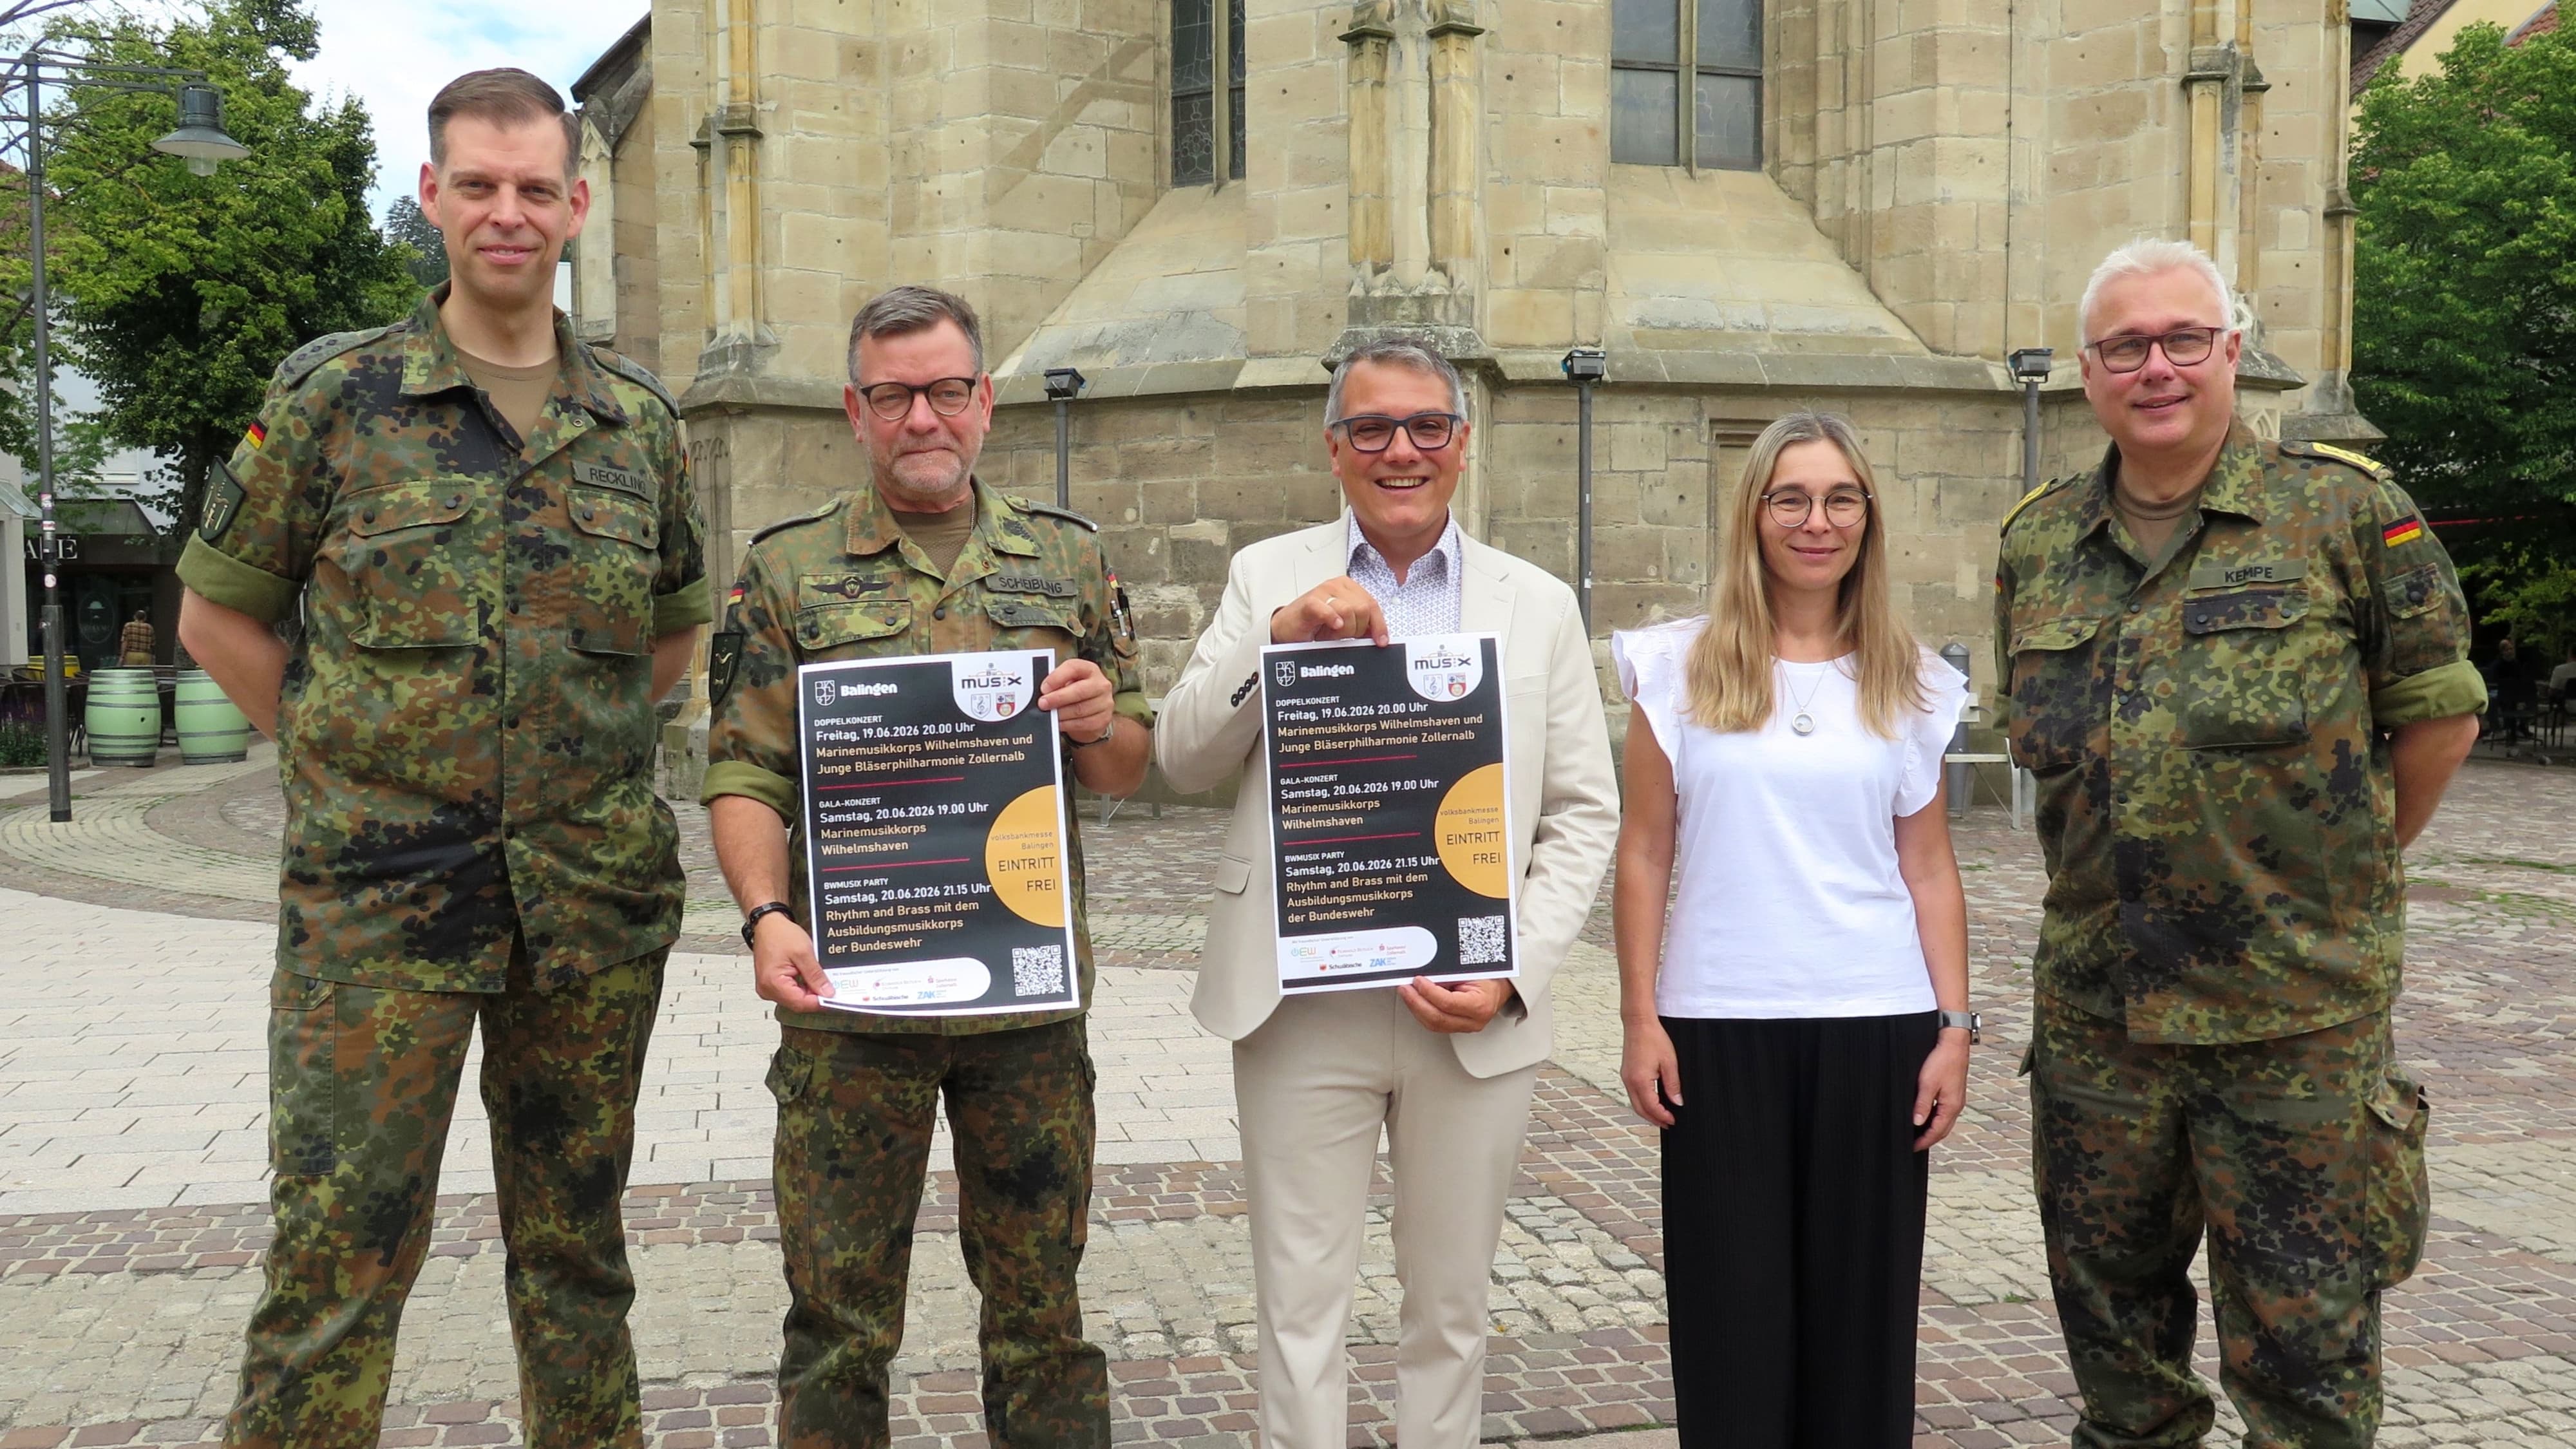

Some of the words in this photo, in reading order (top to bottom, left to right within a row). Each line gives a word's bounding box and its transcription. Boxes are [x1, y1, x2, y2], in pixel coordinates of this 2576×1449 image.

[589, 468, 647, 494] RECKLING
[2225, 567, 2273, 583] KEMPE
[1301, 665, 1354, 677] Balingen
[840, 683, 898, 697] Balingen
[1276, 696, 1340, 706] DOPPELKONZERT
[1278, 710, 1318, 721] Freitag,
[1321, 706, 1374, 717] 19.06.2026
[1378, 703, 1405, 714] 20.00
[1409, 702, 1428, 712] Uhr
[814, 715, 882, 726] DOPPELKONZERT
[1278, 723, 1376, 737] Marinemusikkorps
[1380, 717, 1460, 729] Wilhelmshaven
[1464, 714, 1482, 724] und
[817, 730, 860, 742] Freitag,
[863, 726, 919, 738] 19.06.2026
[923, 724, 952, 734] 20.00
[956, 723, 975, 732] Uhr
[817, 744, 921, 757] Marinemusikkorps
[925, 738, 1009, 750] Wilhelmshaven
[1012, 734, 1032, 744] und
[1279, 743, 1310, 753] Junge
[1314, 736, 1417, 750] Bläserphilharmonie
[1422, 730, 1474, 742] Zollernalb
[817, 764, 851, 775] Junge
[855, 757, 965, 772] Bläserphilharmonie
[969, 751, 1025, 764] Zollernalb
[1280, 775, 1338, 784] GALA-KONZERT
[1282, 788, 1330, 799] Samstag,
[1334, 782, 1388, 795] 20.06.2026
[1391, 781, 1416, 791] 19.00
[1420, 779, 1439, 788] Uhr
[819, 797, 880, 808] GALA-KONZERT
[1282, 800, 1379, 814] Marinemusikkorps
[820, 812, 873, 823] Samstag,
[876, 806, 934, 819] 20.06.2026
[938, 804, 965, 815] 19.00
[969, 802, 989, 813] Uhr
[1440, 807, 1498, 815] volksbankmesse
[1282, 817, 1363, 829] Wilhelmshaven
[822, 824, 926, 838] Marinemusikkorps
[991, 831, 1052, 840] volksbankmesse
[1446, 831, 1500, 845] EINTRITT
[822, 842, 908, 855] Wilhelmshaven
[1285, 853, 1320, 862] BWMUSIX
[1321, 851, 1344, 860] PARTY
[1473, 853, 1501, 864] FREI
[999, 857, 1055, 871] EINTRITT
[1286, 866, 1334, 876] Samstag,
[1338, 859, 1392, 872] 20.06.2026
[1396, 857, 1417, 867] 21.15
[1421, 857, 1439, 866] Uhr
[824, 880, 862, 889] BWMUSIX
[864, 878, 888, 887] PARTY
[1027, 879, 1056, 892] FREI
[1287, 881, 1327, 893] Rhythm
[1331, 878, 1349, 888] and
[1352, 877, 1382, 886] Brass
[1387, 874, 1402, 884] mit
[1406, 873, 1427, 882] dem
[825, 893, 878, 904] Samstag,
[881, 886, 940, 900] 20.06.2026
[943, 884, 967, 895] 21.15
[971, 884, 991, 893] Uhr
[1287, 891, 1413, 907] Ausbildungsmusikkorps
[826, 909, 869, 922] Rhythm
[873, 907, 893, 917] and
[898, 905, 930, 915] Brass
[934, 902, 951, 912] mit
[956, 902, 979, 911] dem
[1288, 913, 1305, 922] der
[1309, 907, 1374, 921] Bundeswehr
[828, 920, 963, 937] Ausbildungsmusikkorps
[828, 944, 848, 954] der
[851, 938, 922, 952] Bundeswehr
[1370, 958, 1386, 967] ZAK
[918, 990, 935, 1000] ZAK
